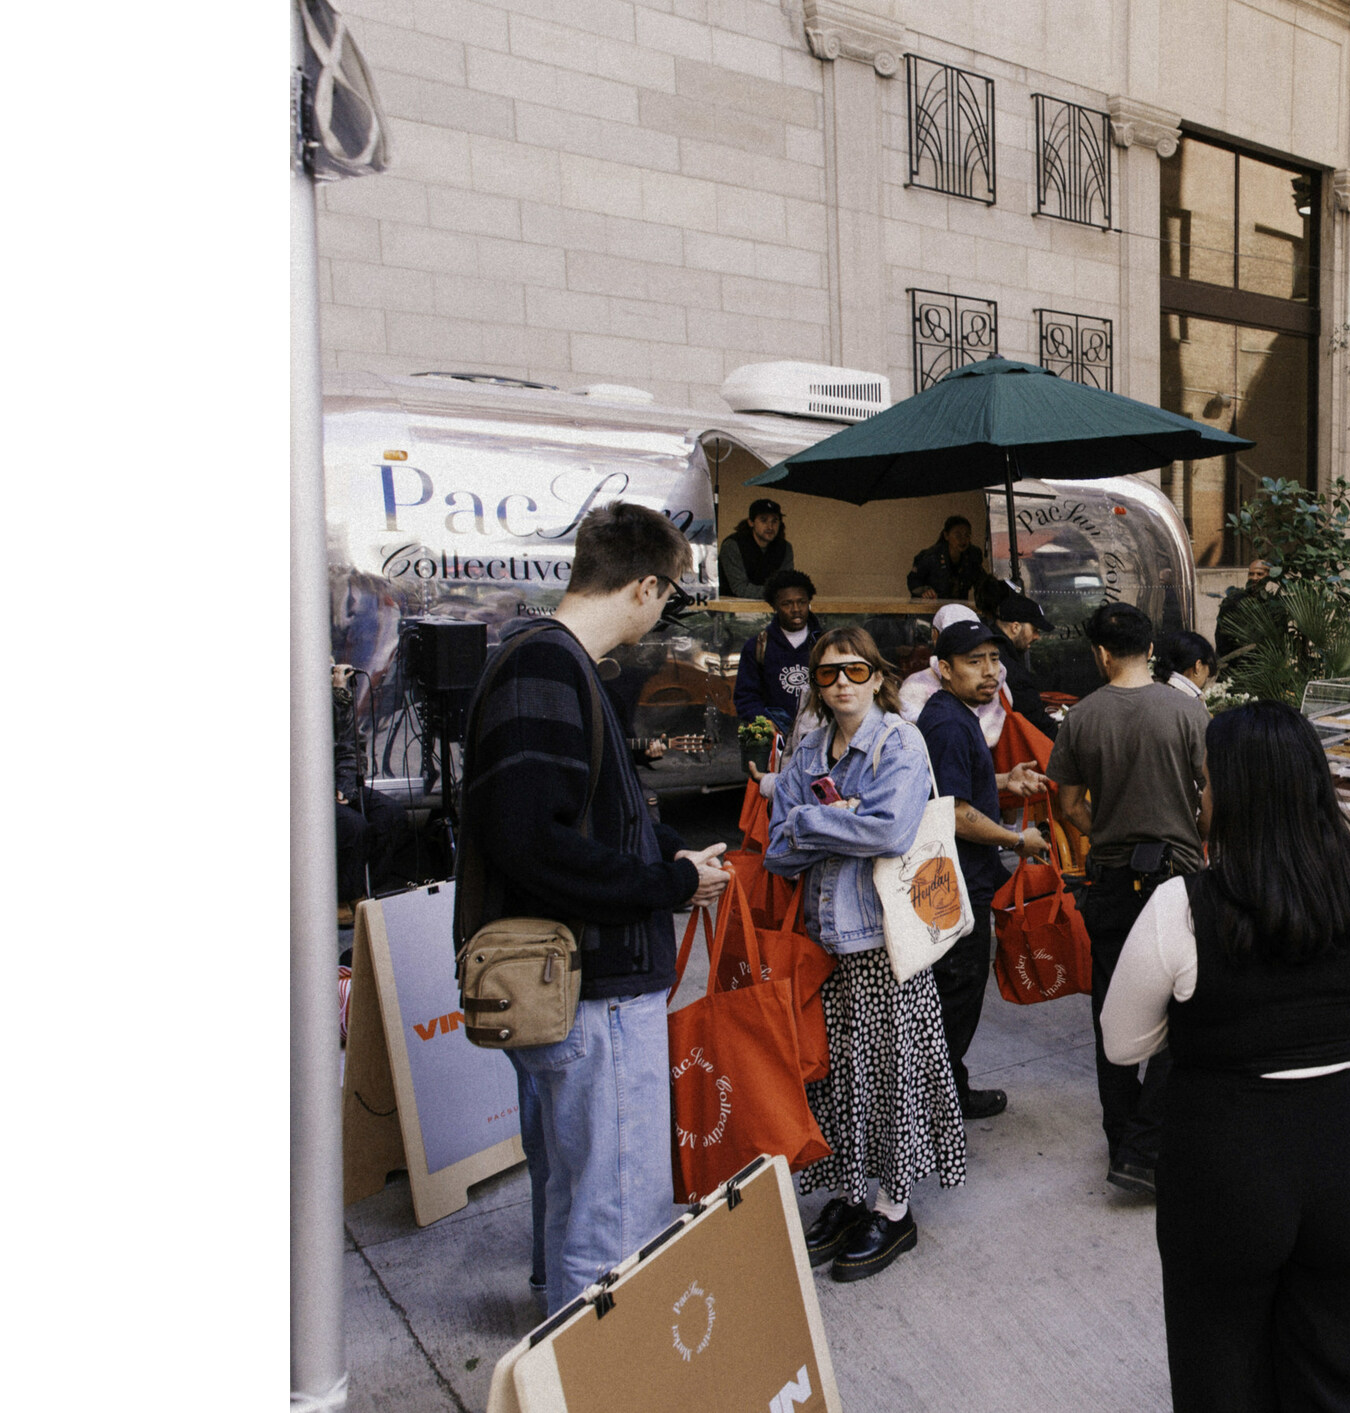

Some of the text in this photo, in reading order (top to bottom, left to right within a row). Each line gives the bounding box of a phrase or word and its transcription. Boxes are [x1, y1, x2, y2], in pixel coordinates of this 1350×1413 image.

[1017, 500, 1100, 535] PacSun
[380, 543, 572, 583] Collective
[906, 871, 950, 908] Heyday
[1015, 955, 1035, 990] Market
[487, 1106, 519, 1123] PACSU
[671, 1047, 714, 1080] acSun
[702, 1075, 733, 1148] Collective
[672, 1280, 716, 1362] PacSun Collective Market
